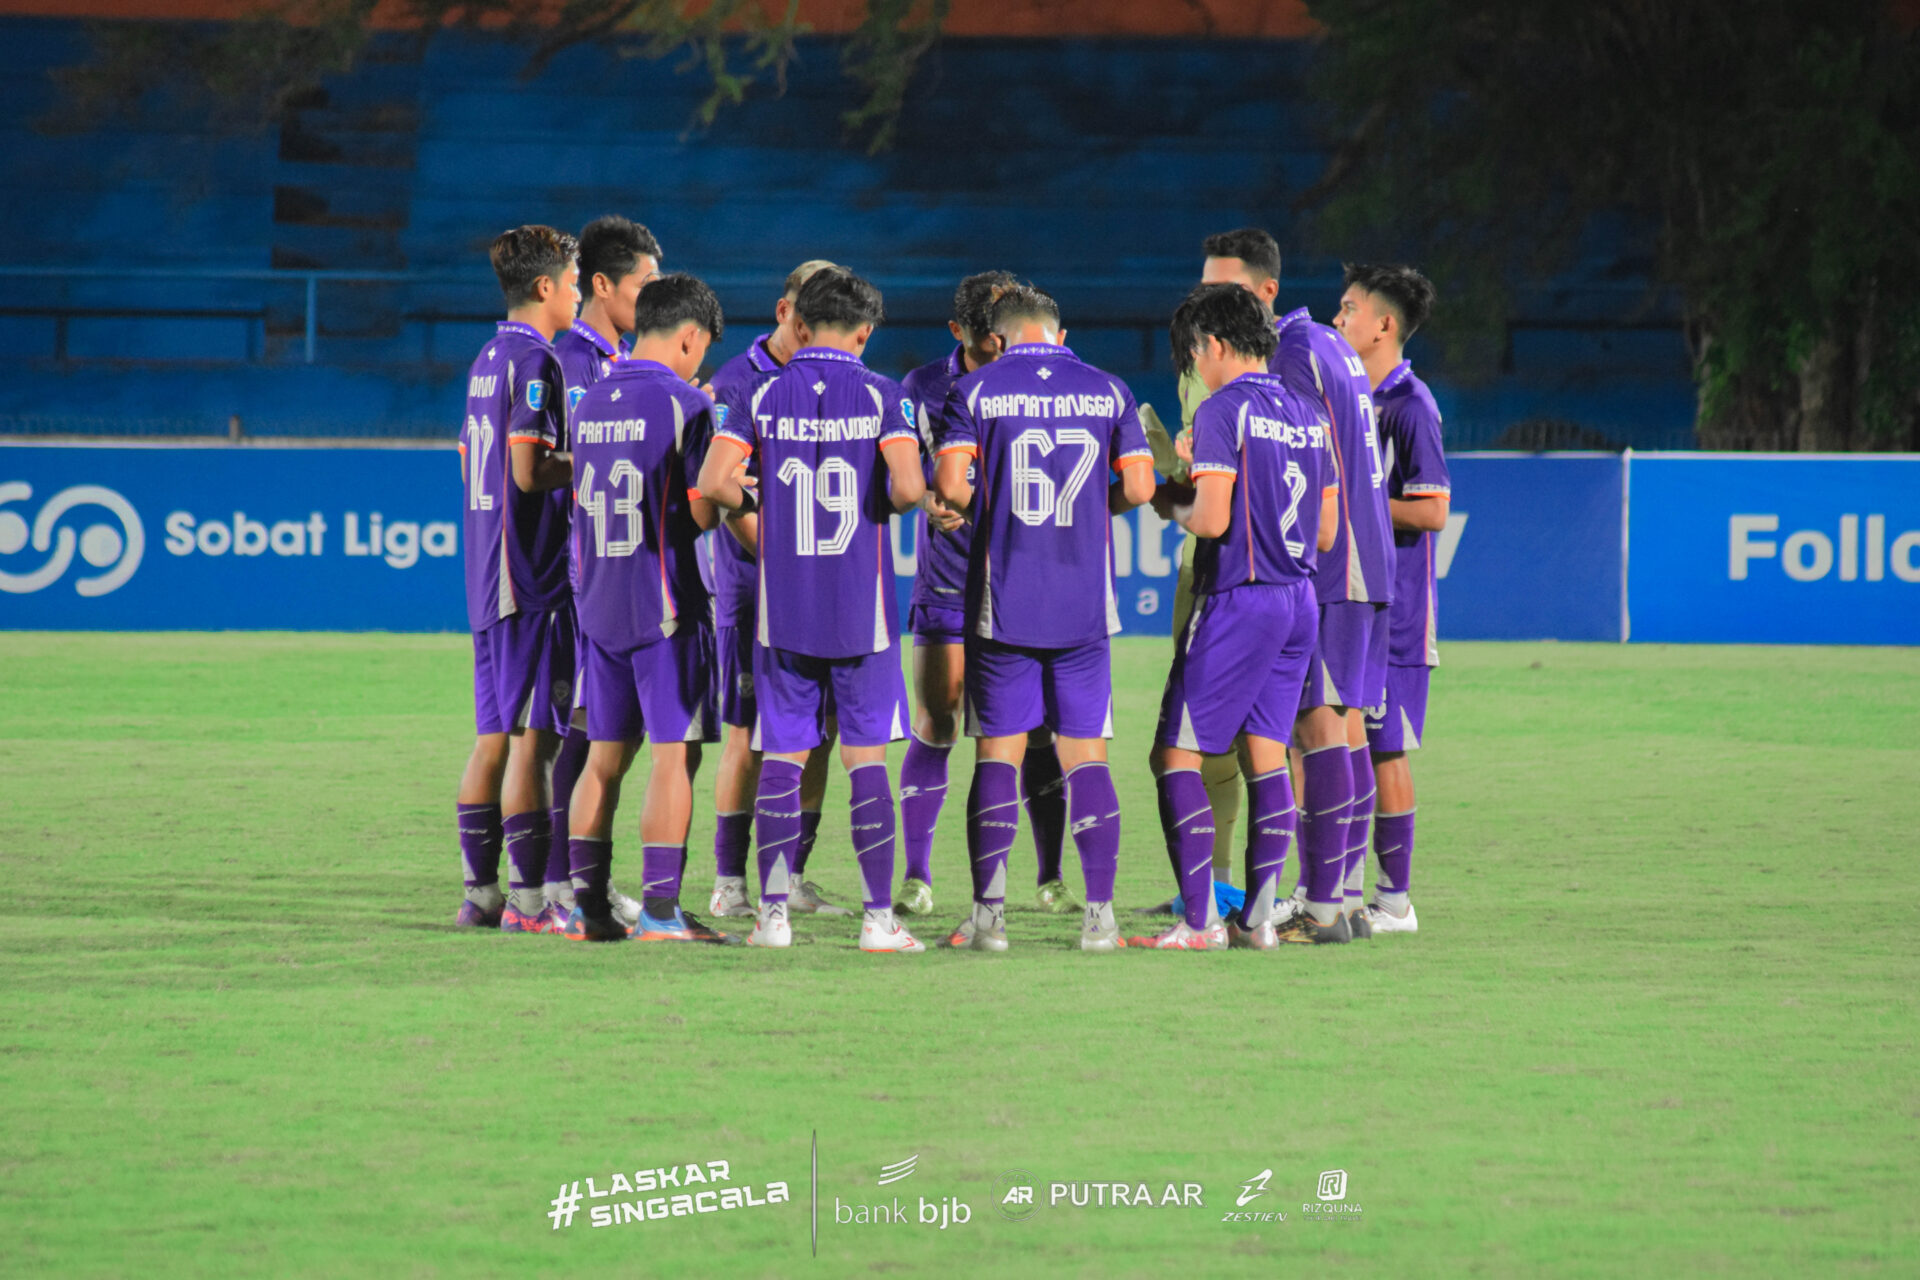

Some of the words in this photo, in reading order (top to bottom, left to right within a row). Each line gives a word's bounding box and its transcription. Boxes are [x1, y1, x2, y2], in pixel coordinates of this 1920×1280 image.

[577, 418, 646, 444] PRATAMA
[757, 414, 774, 439] T.
[777, 416, 882, 442] ALESSANDRO
[980, 394, 1053, 420] RAHMAT
[1054, 394, 1115, 419] ANGGA
[468, 414, 494, 511] 12
[578, 459, 643, 558] 43
[777, 456, 858, 556] 19
[1011, 428, 1100, 527] 67
[1279, 461, 1307, 559] 2
[164, 510, 327, 557] Sobat
[344, 511, 457, 569] Liga
